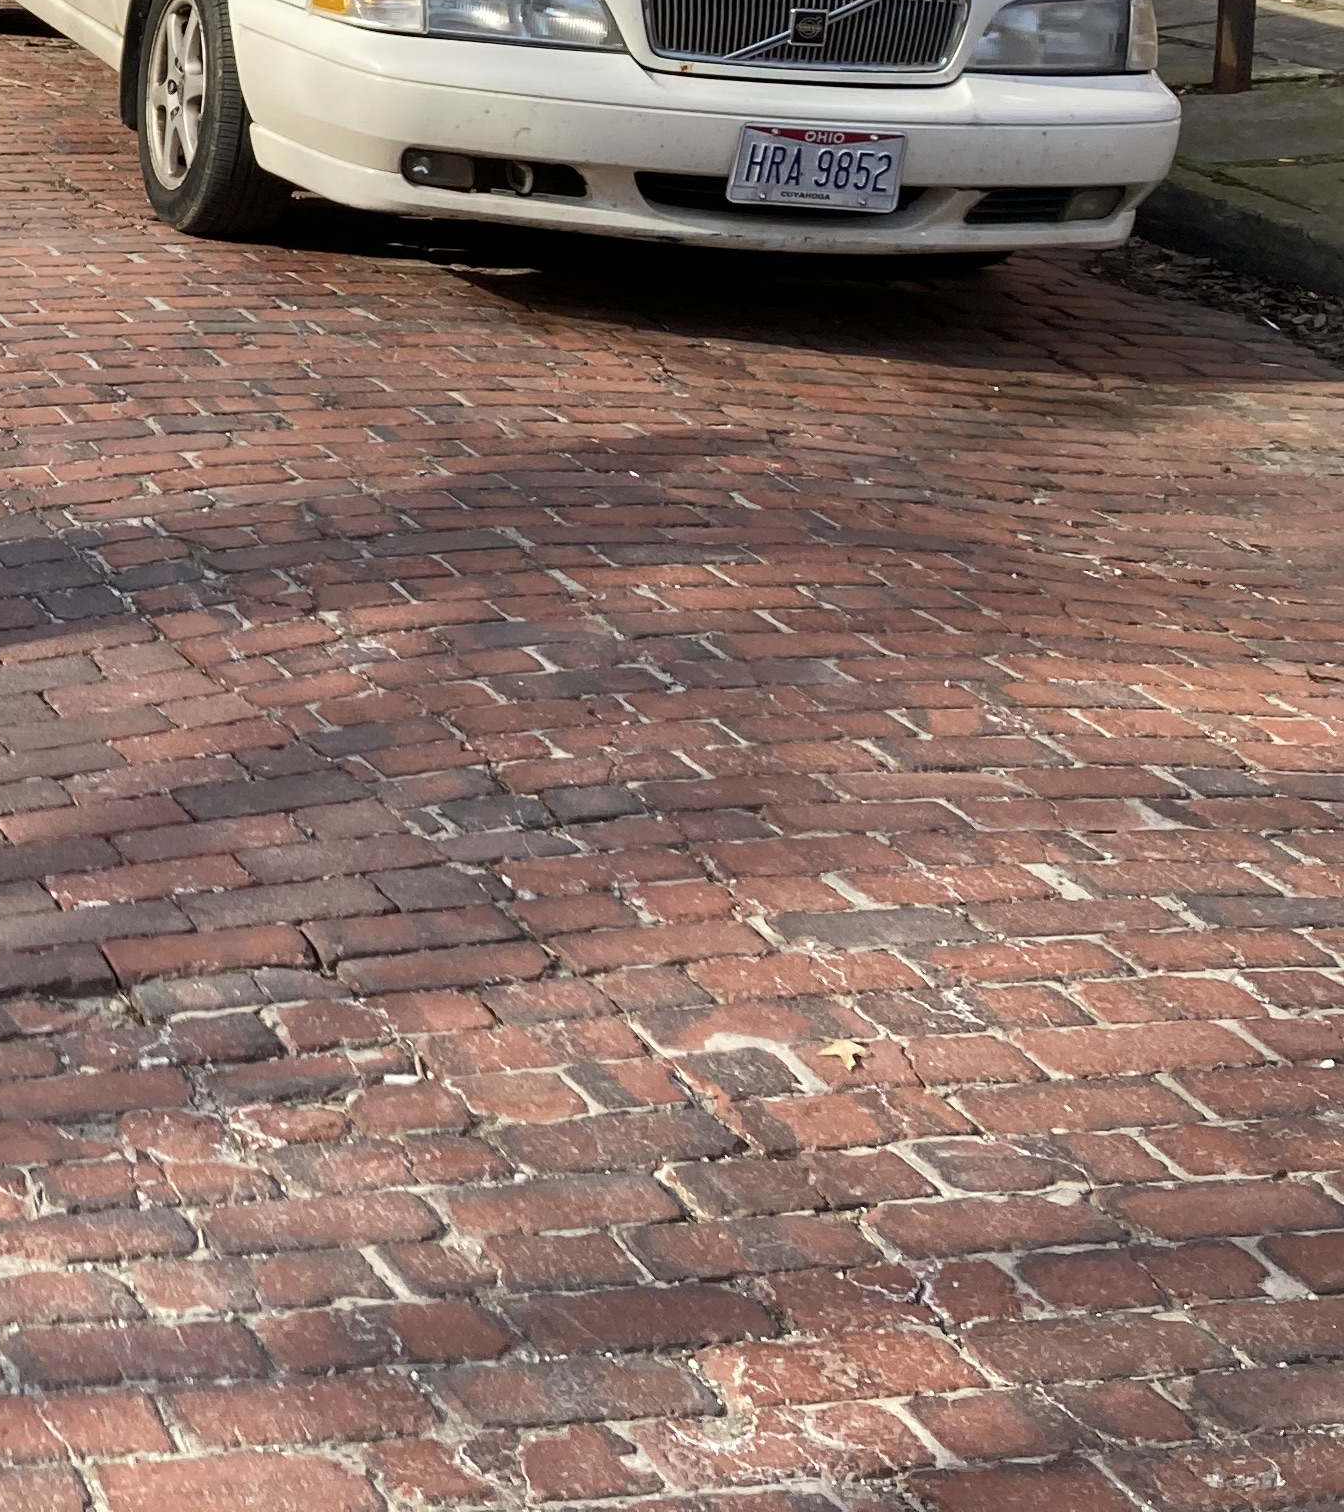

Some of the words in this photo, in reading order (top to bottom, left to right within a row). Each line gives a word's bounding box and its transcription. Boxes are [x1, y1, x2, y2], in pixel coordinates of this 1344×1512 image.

[804, 130, 845, 144] OHIO
[744, 142, 803, 186] HRA
[813, 148, 892, 192] 9852
